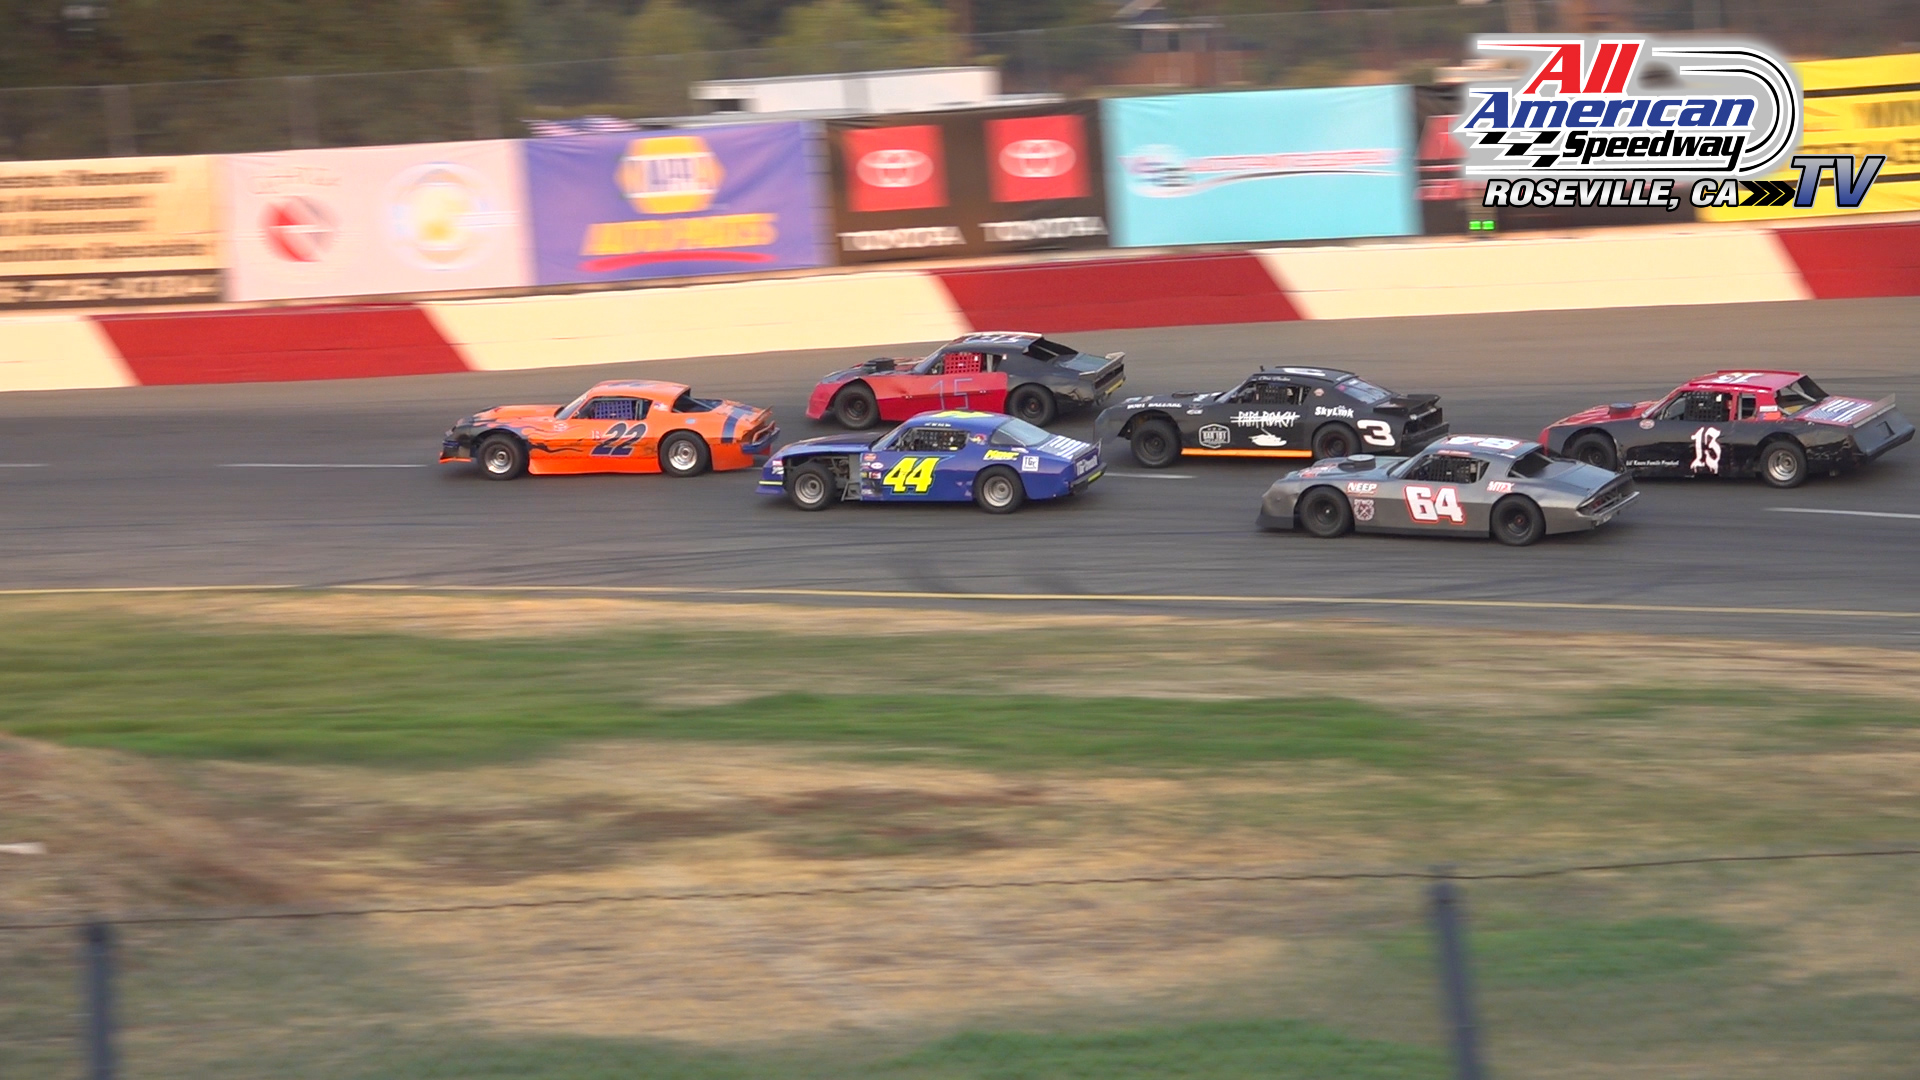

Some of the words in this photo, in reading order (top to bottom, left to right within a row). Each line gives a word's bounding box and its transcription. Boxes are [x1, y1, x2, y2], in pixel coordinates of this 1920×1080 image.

[929, 378, 973, 411] 15
[590, 421, 647, 457] 22
[1356, 419, 1396, 447] 3
[1690, 426, 1722, 475] 13
[882, 456, 941, 493] 44
[1404, 485, 1466, 525] 64
